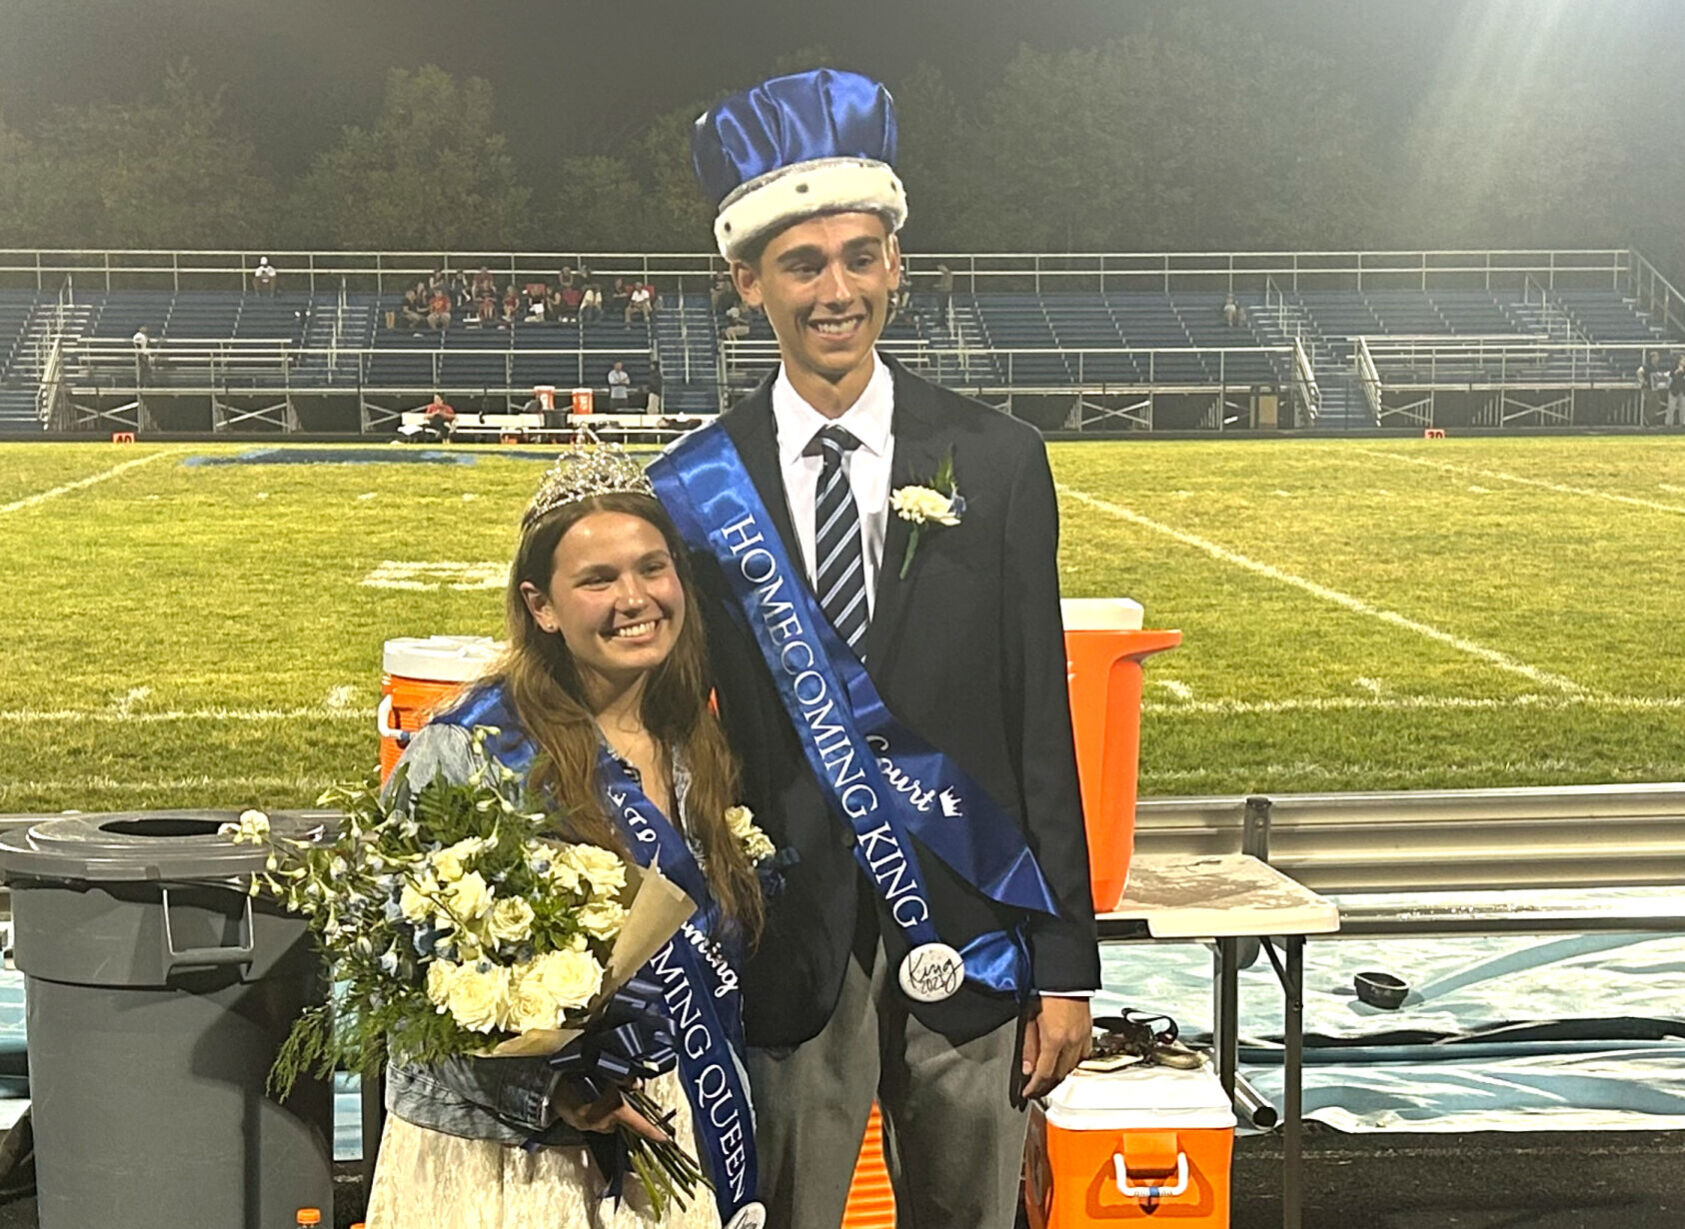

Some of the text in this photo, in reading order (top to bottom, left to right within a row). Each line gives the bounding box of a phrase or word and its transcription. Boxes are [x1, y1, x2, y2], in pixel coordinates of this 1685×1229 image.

[720, 513, 929, 929] HOMECOMING KING
[694, 1064, 746, 1204] QUEEN
